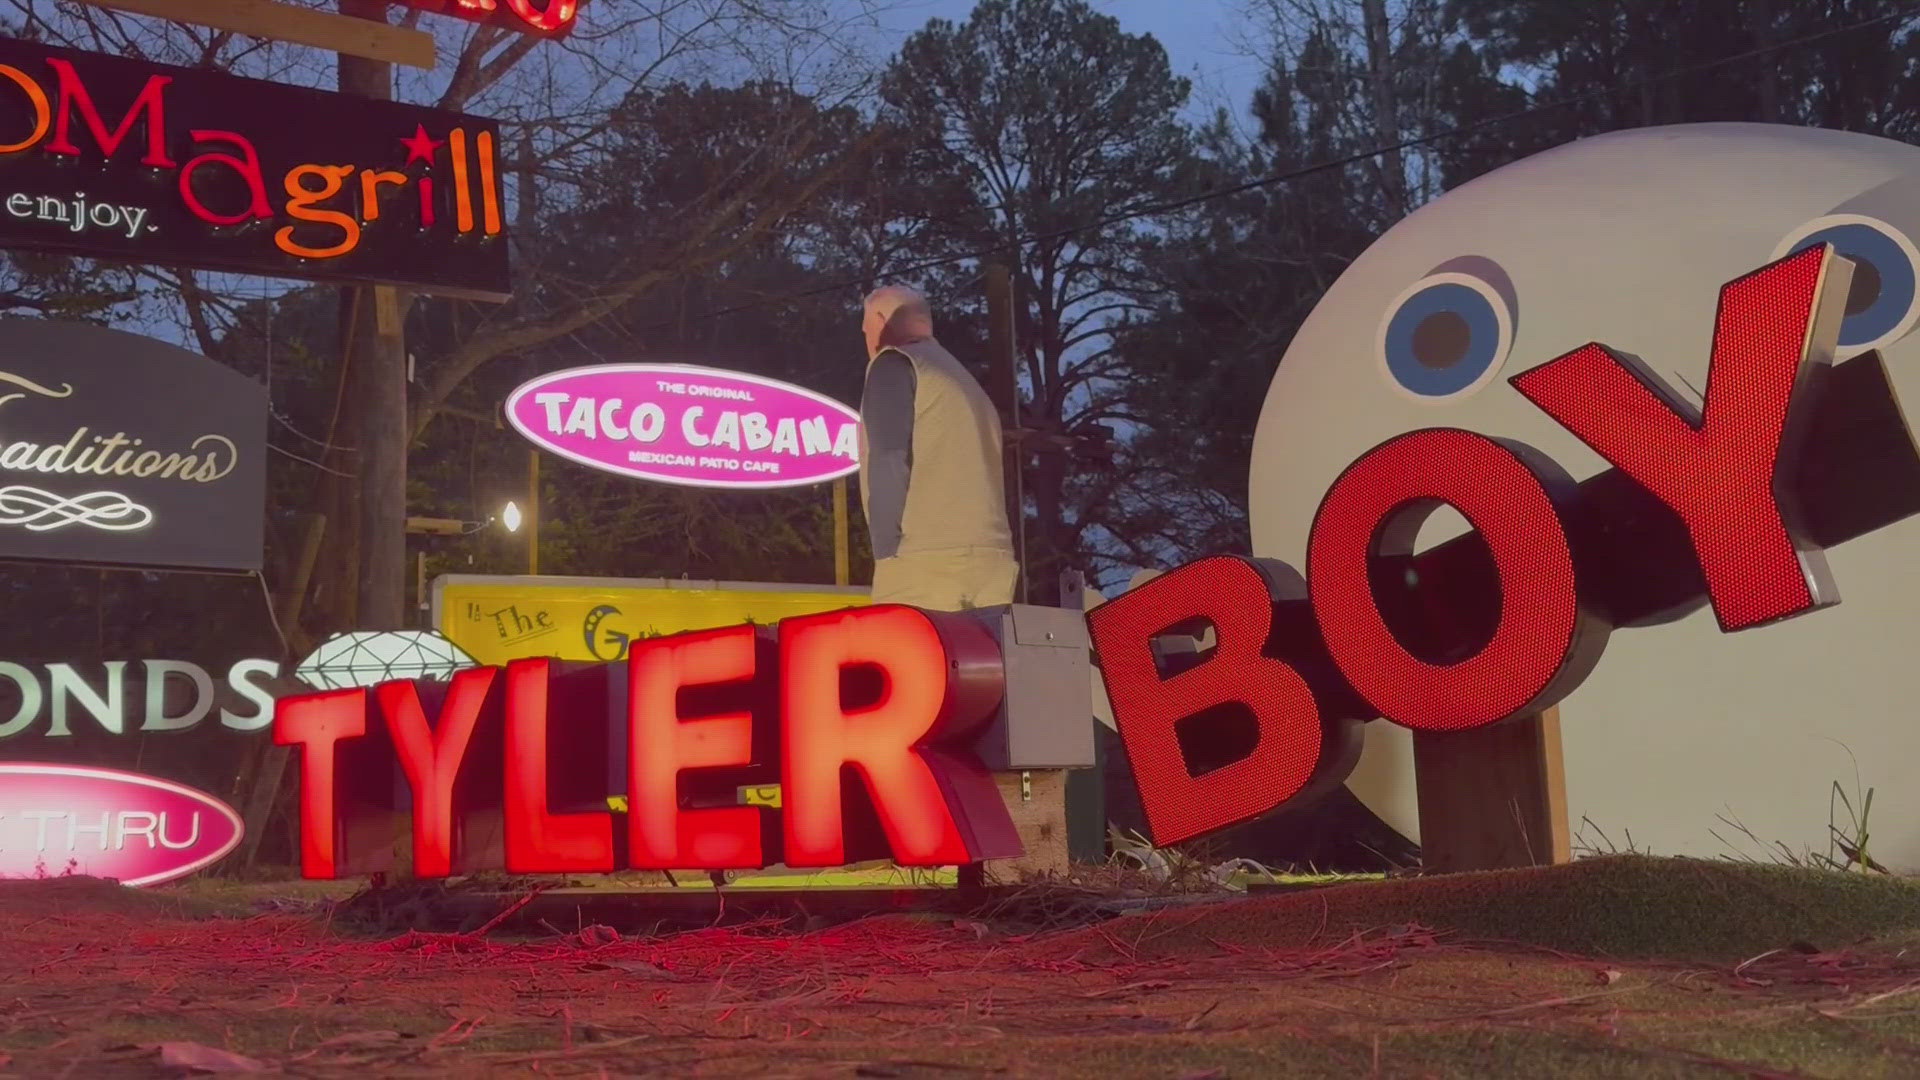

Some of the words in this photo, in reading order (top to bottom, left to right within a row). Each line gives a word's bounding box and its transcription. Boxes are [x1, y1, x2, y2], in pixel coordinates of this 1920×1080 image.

[6, 191, 159, 238] enjoy.
[656, 381, 685, 395] THE
[688, 384, 755, 401] ORIGINAL
[535, 392, 666, 442] TACO
[681, 406, 859, 462] CABANA
[0, 426, 238, 482] aditions
[629, 450, 696, 467] MEXICAN
[699, 456, 740, 470] PATIO
[742, 460, 780, 474] CAFE
[1084, 241, 1835, 850] BOY
[272, 604, 971, 880] TYLER
[21, 811, 200, 851] THRU
